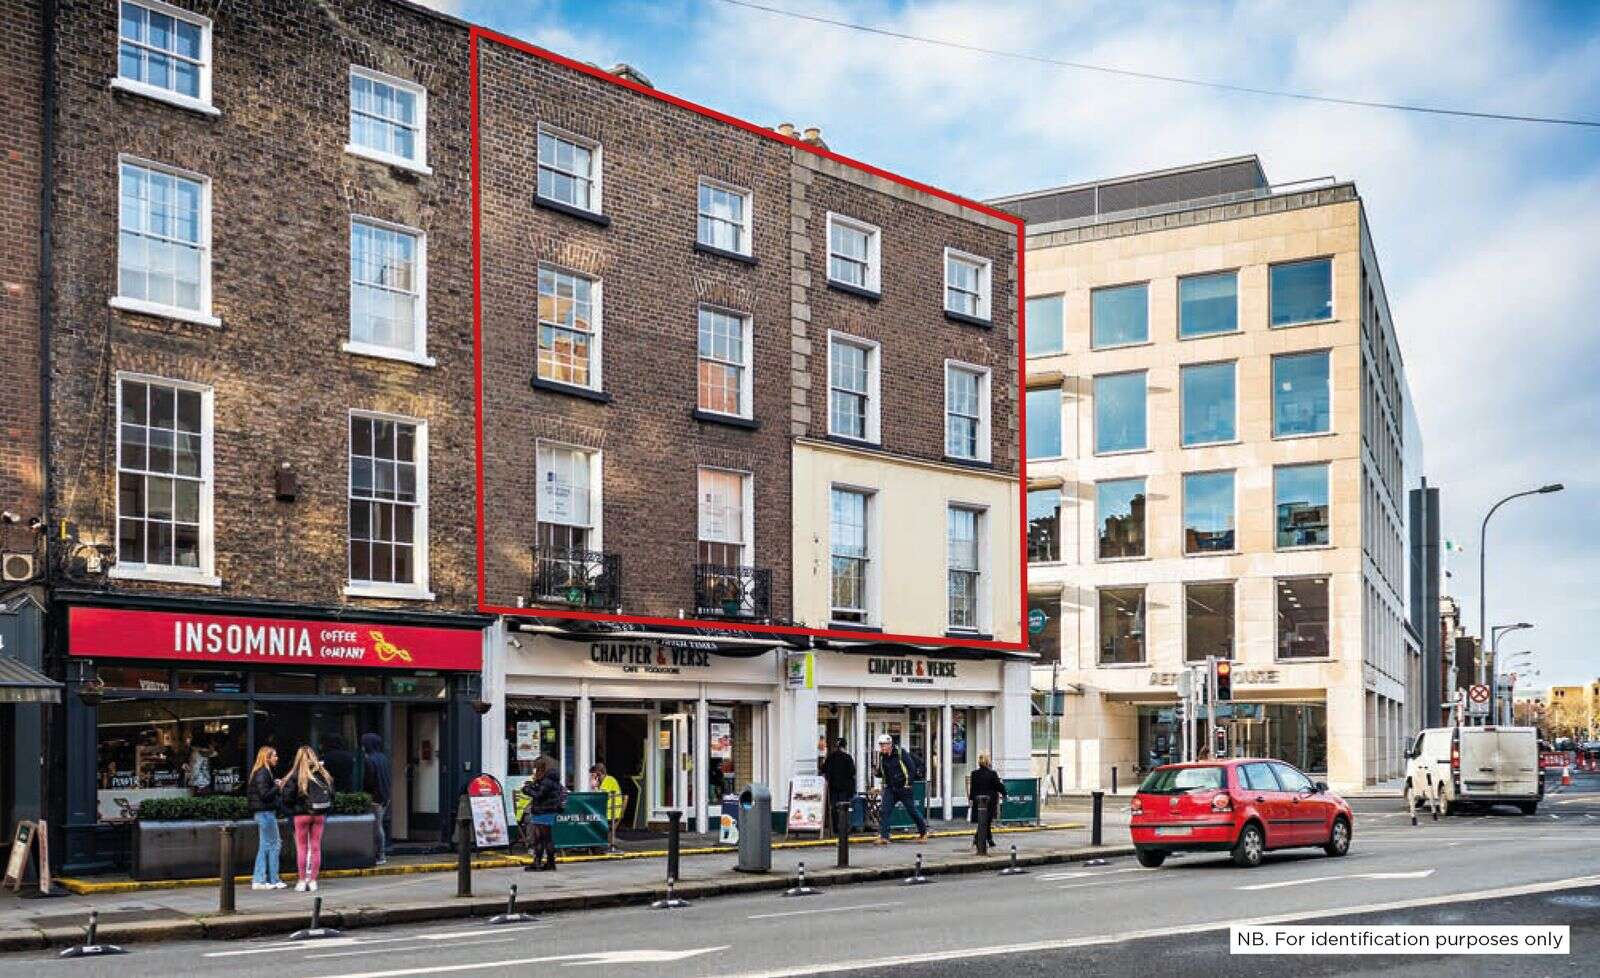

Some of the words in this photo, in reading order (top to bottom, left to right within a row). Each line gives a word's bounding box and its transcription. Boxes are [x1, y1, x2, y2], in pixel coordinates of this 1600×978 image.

[174, 621, 313, 657] INSOMNIA
[320, 630, 357, 642] COFFEE
[320, 647, 366, 659] COMPANY
[591, 643, 652, 664] CHAPTER
[656, 646, 667, 666] &
[671, 647, 711, 667] VERSE
[868, 658, 913, 676] CHAPTER
[916, 660, 925, 677] &
[927, 661, 957, 678] VERSE
